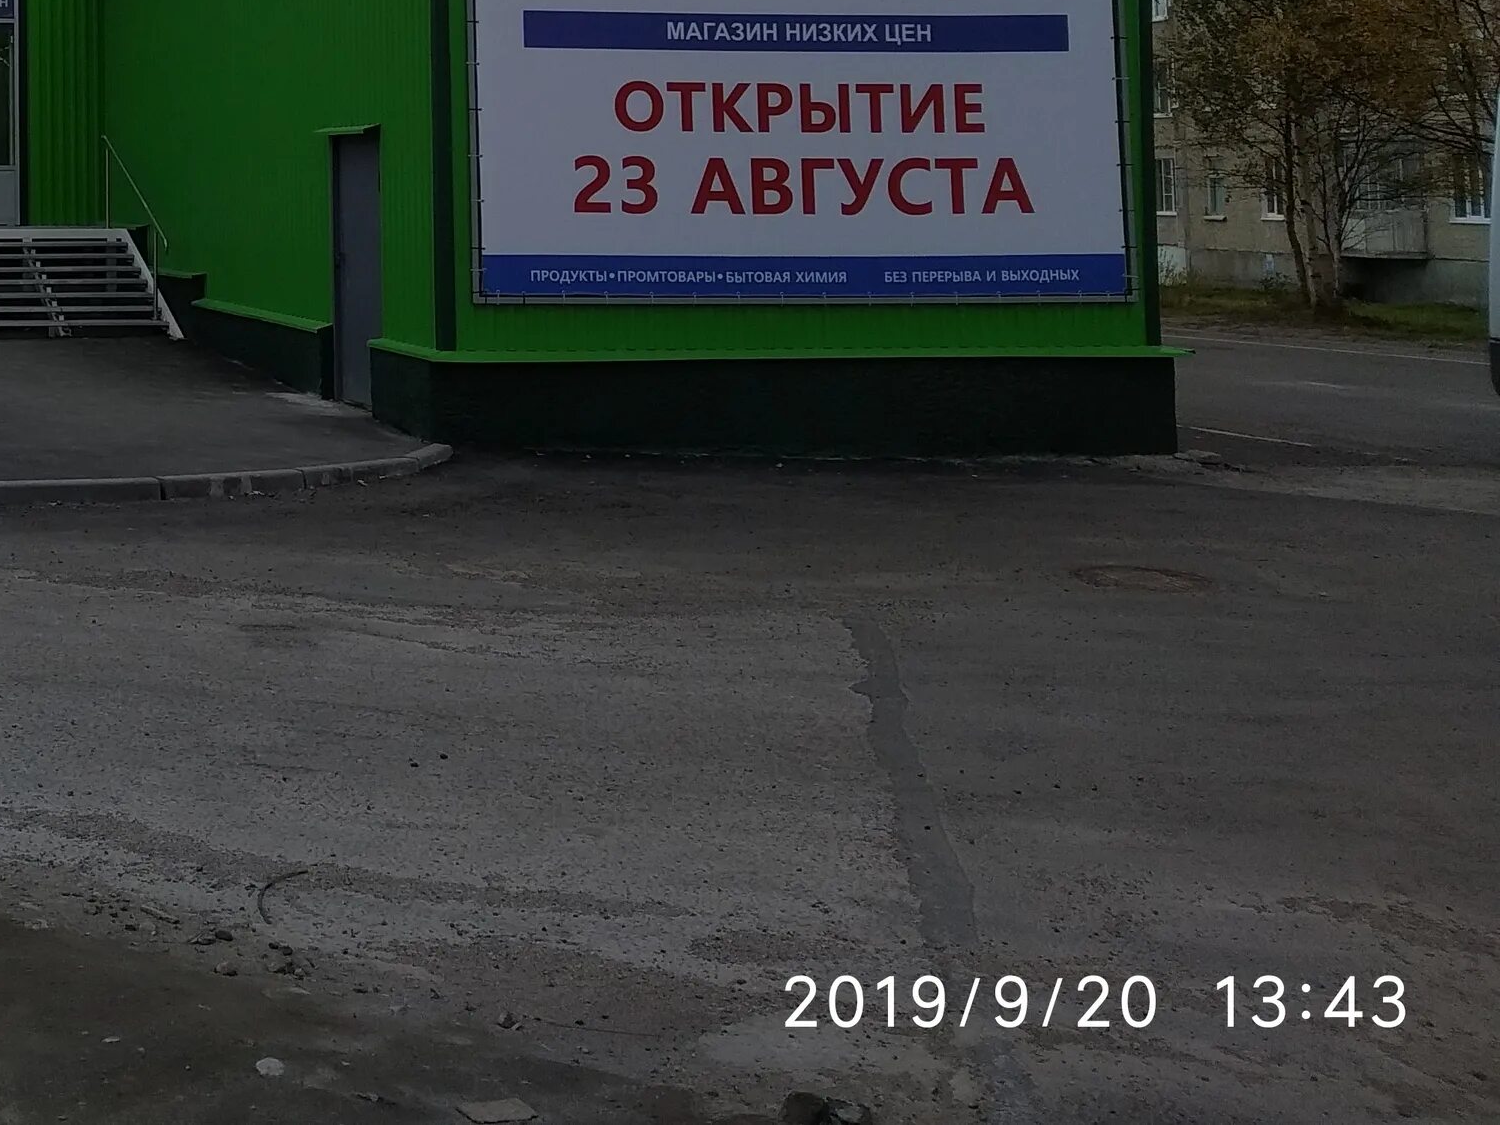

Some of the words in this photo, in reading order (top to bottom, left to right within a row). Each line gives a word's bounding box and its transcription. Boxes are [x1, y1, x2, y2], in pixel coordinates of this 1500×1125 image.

[666, 21, 779, 42] МАГАЗИН
[785, 22, 879, 43] НИЗКИХ
[885, 24, 932, 46] ЦЕН
[614, 80, 986, 134] ОТКРЫТИЕ
[572, 154, 659, 215] 23
[690, 156, 1035, 216] АВГУСТА
[530, 269, 608, 284] ПРОДУКТЫ
[617, 270, 716, 284] ПРОМТОВАРЫ
[725, 271, 791, 284] БЫТОВАЯ
[795, 271, 847, 284] ХИМИЯ
[884, 271, 908, 283] БЕЗ
[912, 270, 982, 283] ПЕРЕРЫВА
[986, 270, 997, 282] И
[1001, 269, 1080, 283] ВЫХОДНЫХ
